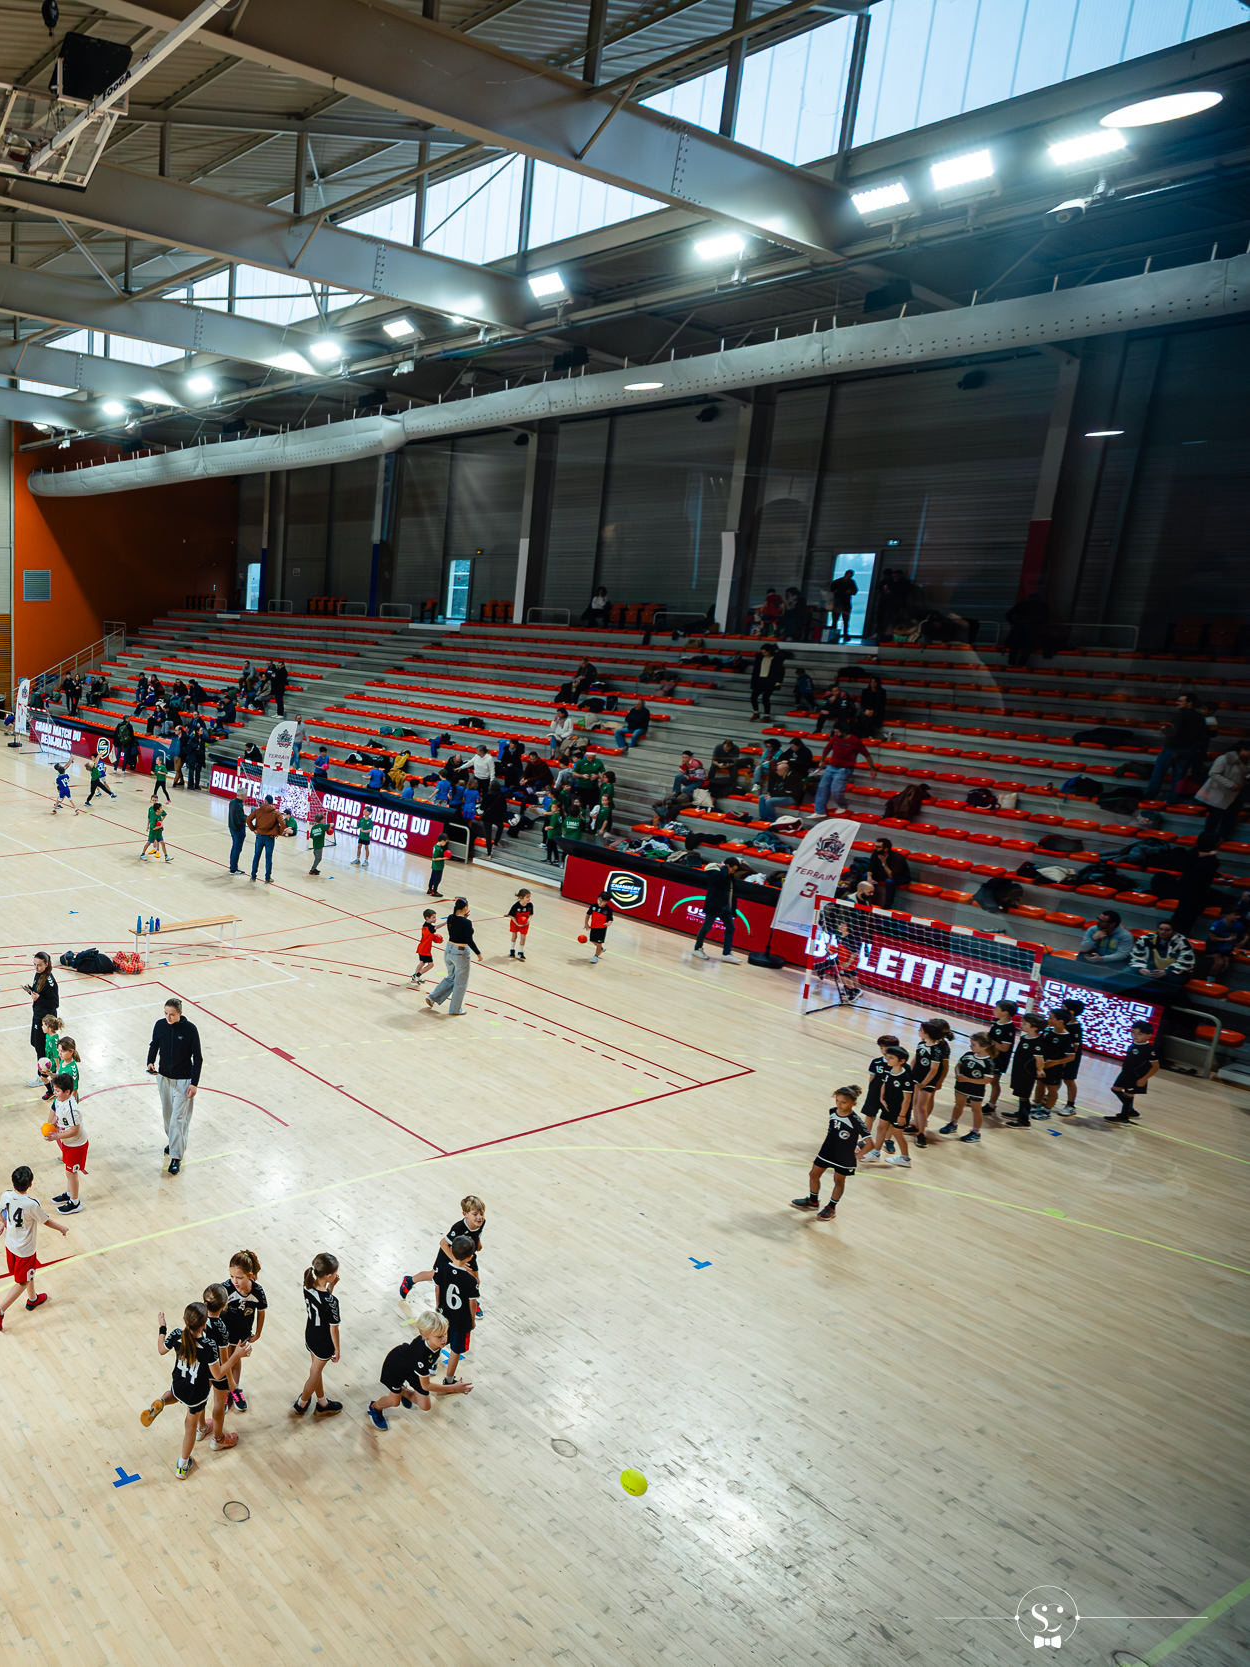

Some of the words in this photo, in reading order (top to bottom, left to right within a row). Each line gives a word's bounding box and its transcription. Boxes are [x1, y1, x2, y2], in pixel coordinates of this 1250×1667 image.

[323, 794, 361, 817] GRAND
[410, 817, 430, 836] DU
[795, 866, 837, 881] TERRAIN
[799, 881, 818, 898] 3
[6, 1202, 23, 1228] 14
[445, 1283, 463, 1310] 6
